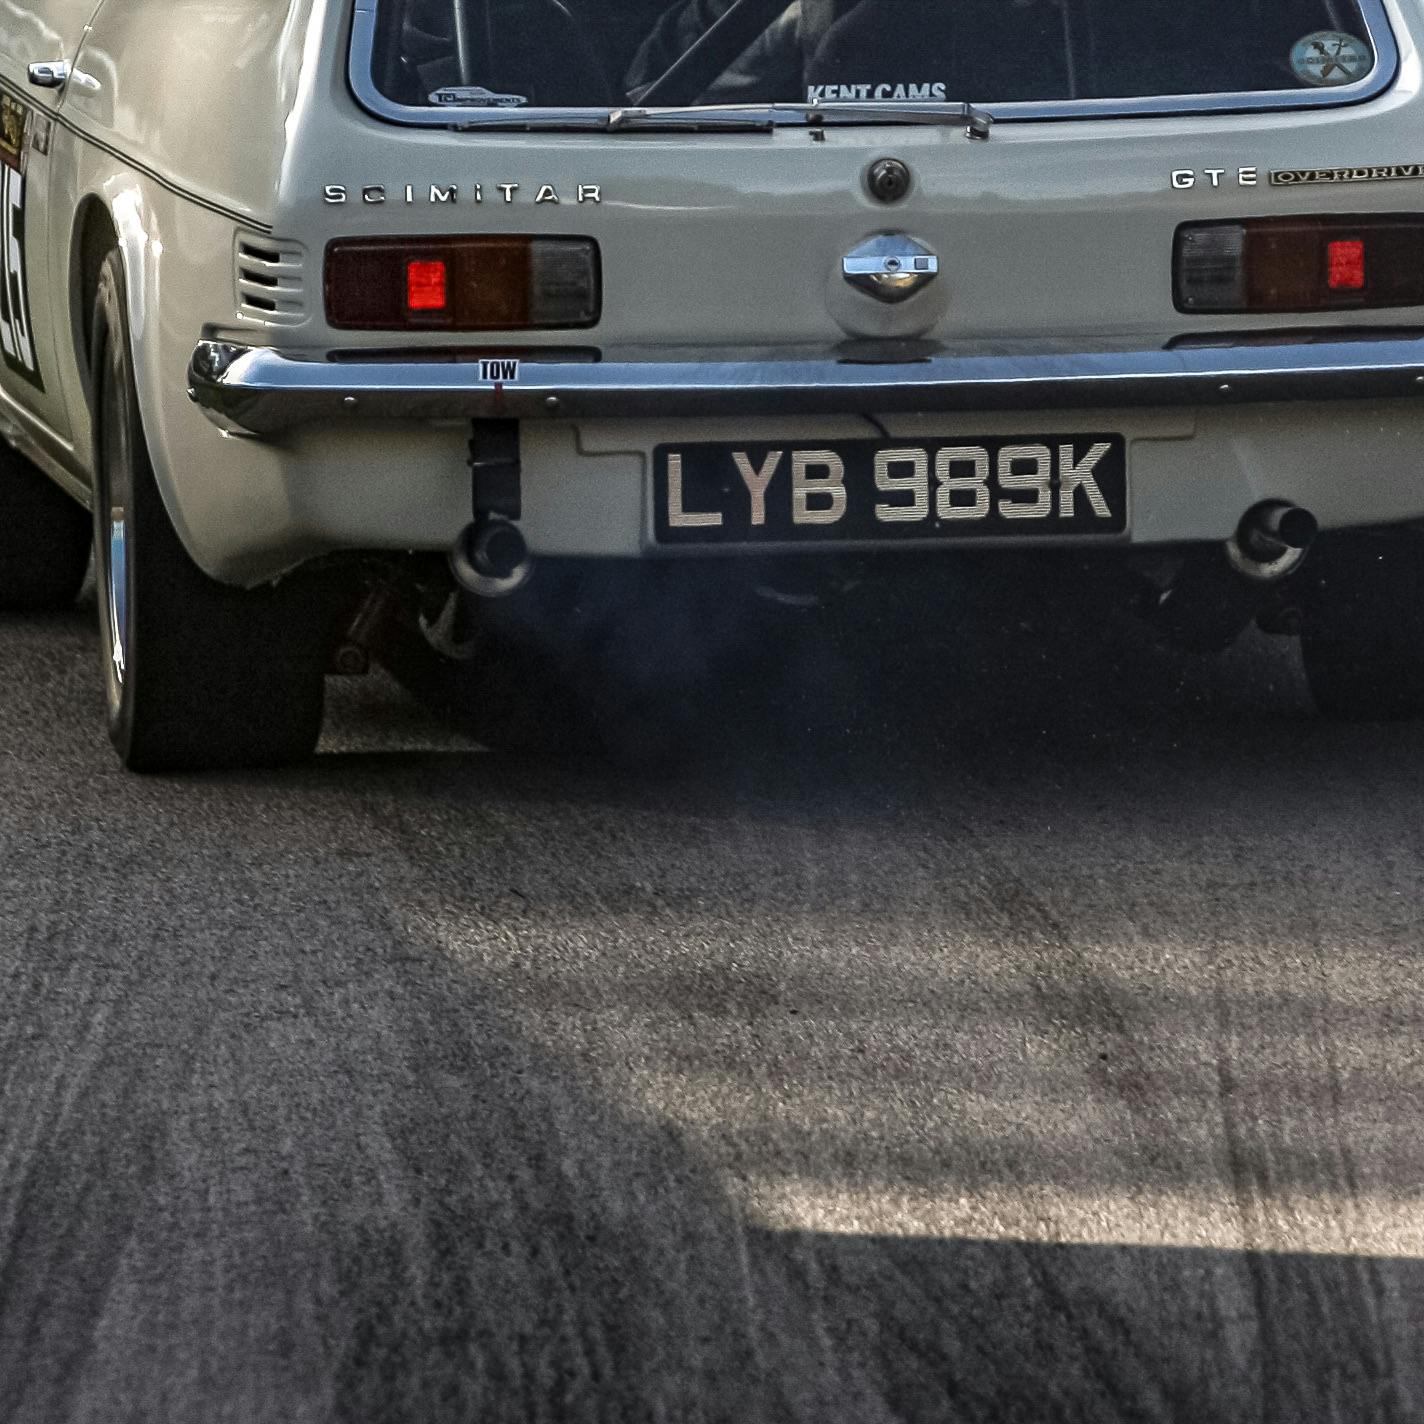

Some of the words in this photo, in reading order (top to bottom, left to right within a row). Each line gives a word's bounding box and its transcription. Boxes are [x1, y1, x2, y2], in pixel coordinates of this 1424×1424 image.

[807, 84, 871, 101] KENT
[874, 82, 947, 101] CAMS
[1171, 166, 1257, 189] GTE
[324, 183, 601, 204] SCIMITAR
[480, 360, 517, 380] TOW
[667, 449, 847, 527] LYB
[875, 442, 1113, 523] 989K
